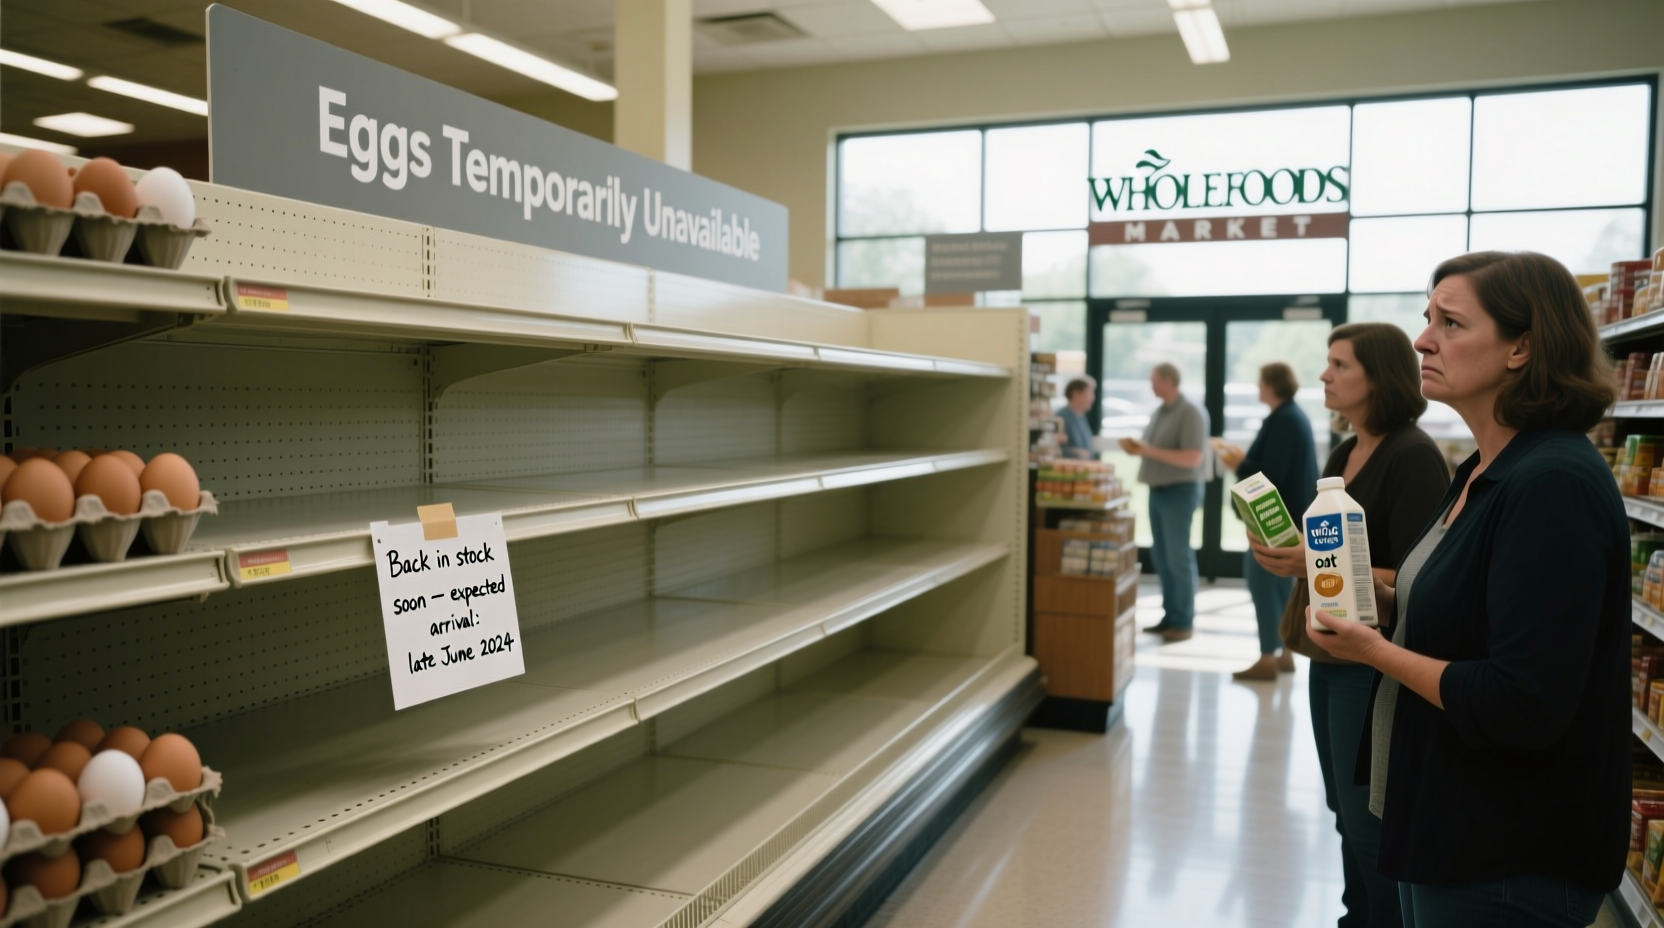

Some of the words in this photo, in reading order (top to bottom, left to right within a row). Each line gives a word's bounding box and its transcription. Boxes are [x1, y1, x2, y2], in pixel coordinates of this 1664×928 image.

[318, 85, 432, 190] Eggs
[442, 124, 637, 244] Temporarily
[643, 187, 761, 262] Unavailable
[1124, 215, 1311, 242] MARKET
[386, 549, 431, 578] Back
[436, 550, 450, 568] in
[456, 542, 495, 566] stock
[393, 594, 427, 615] soon
[450, 573, 505, 607] expected
[430, 609, 480, 636] arrival:
[408, 651, 437, 674] late
[440, 645, 475, 666] June
[480, 632, 514, 657] 2024
